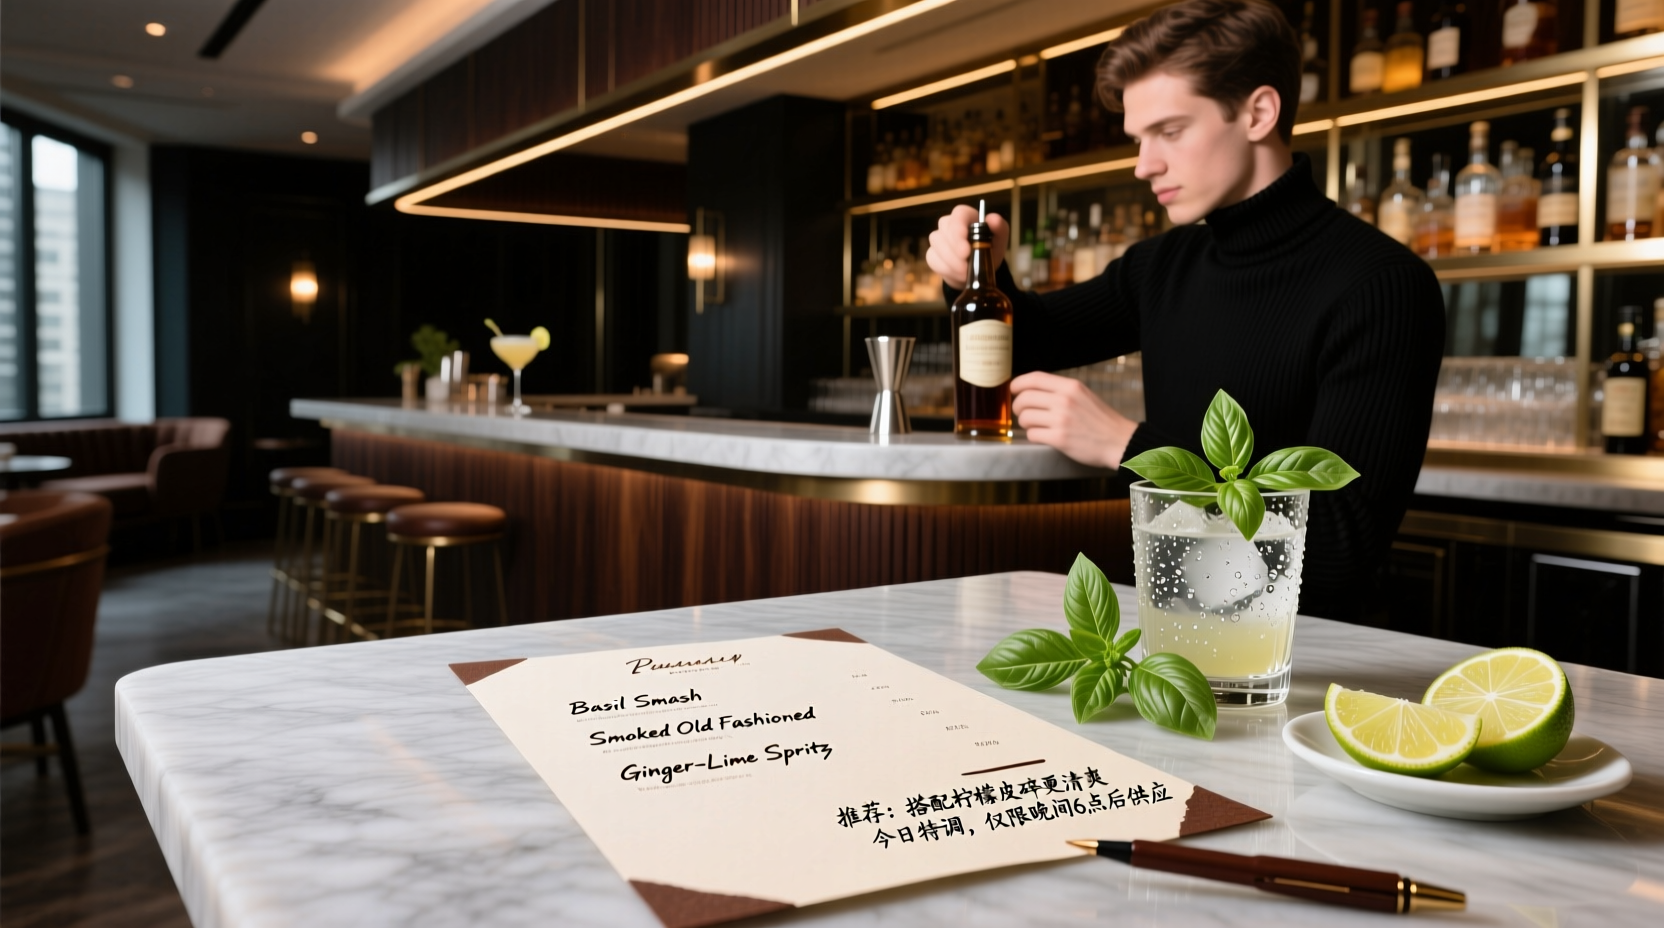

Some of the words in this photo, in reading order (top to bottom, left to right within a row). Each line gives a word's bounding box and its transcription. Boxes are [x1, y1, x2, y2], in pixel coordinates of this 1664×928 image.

[569, 701, 625, 716] Basil
[633, 688, 702, 708] Smash
[589, 723, 671, 746] Smoked
[676, 717, 714, 735] Old
[719, 706, 816, 731] Fashioned
[620, 753, 759, 784] Ginger-Lime
[764, 741, 833, 766] Spritz
